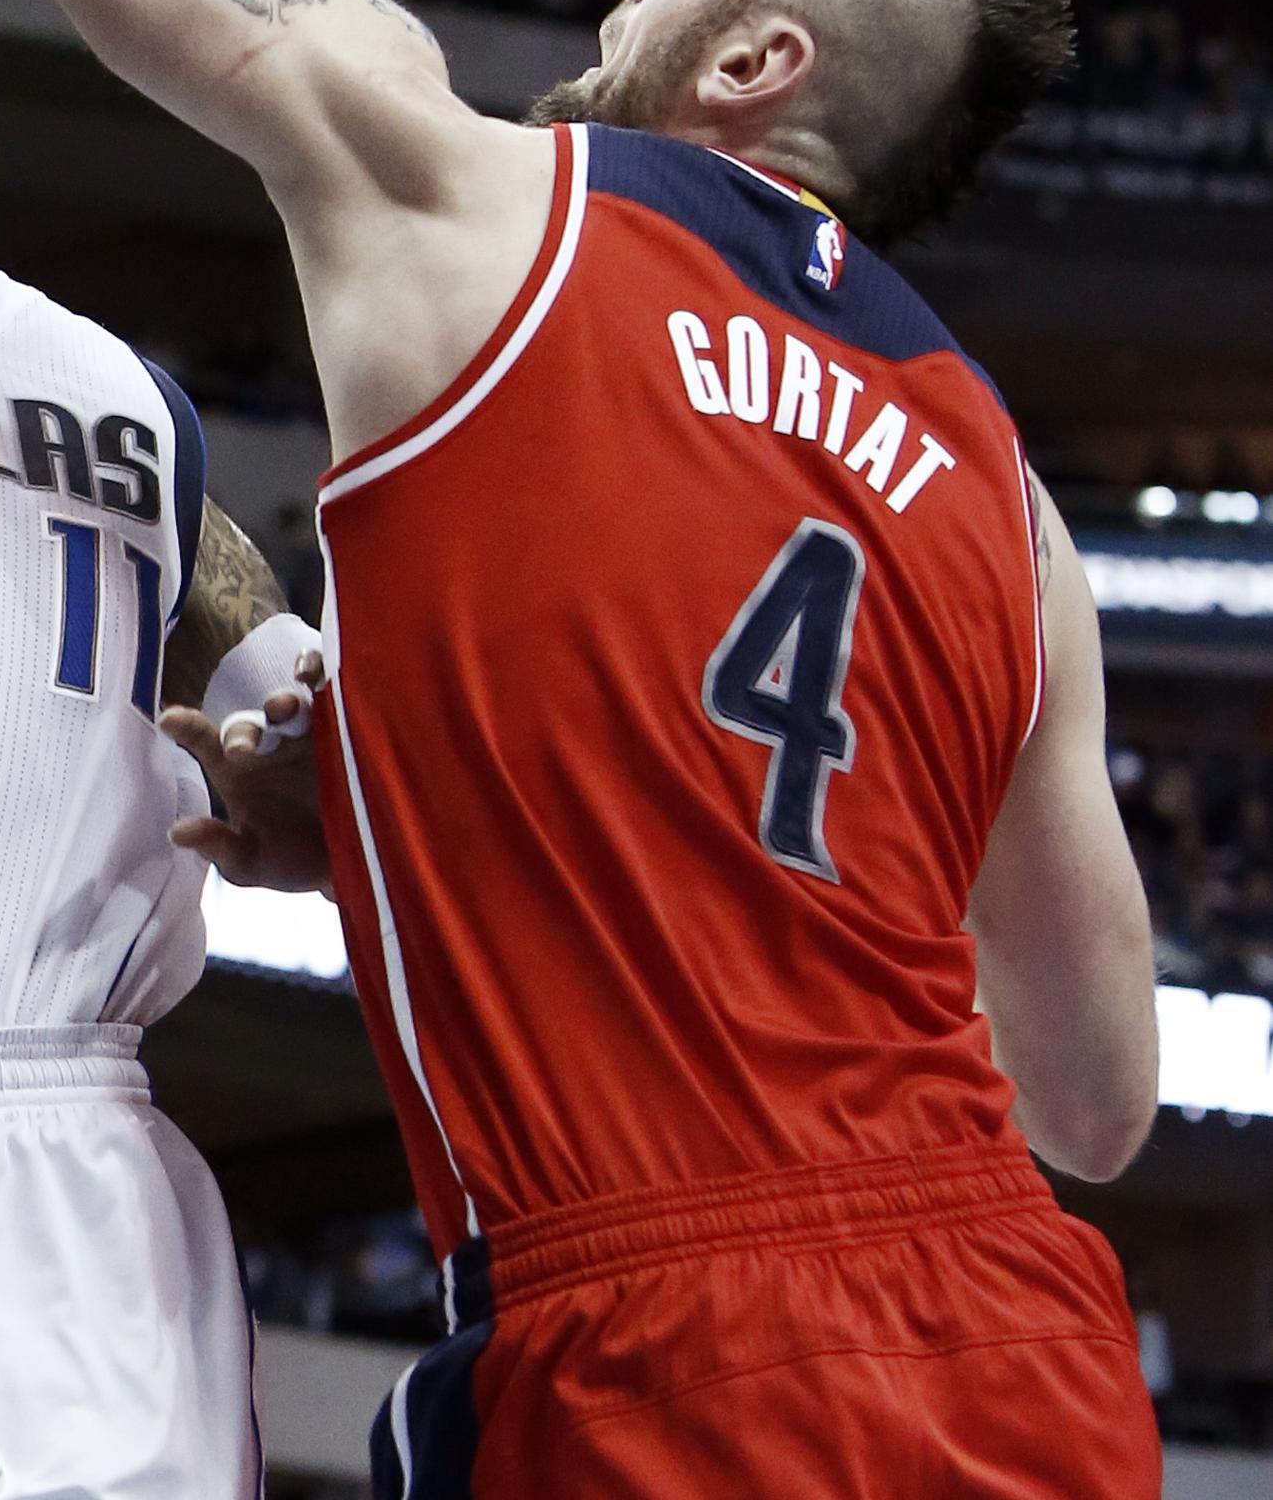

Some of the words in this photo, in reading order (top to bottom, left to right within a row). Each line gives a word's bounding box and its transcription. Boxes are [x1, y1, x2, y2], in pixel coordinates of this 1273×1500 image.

[666, 310, 957, 515] GORTAT
[45, 514, 164, 725] 11
[702, 516, 866, 886] 4
